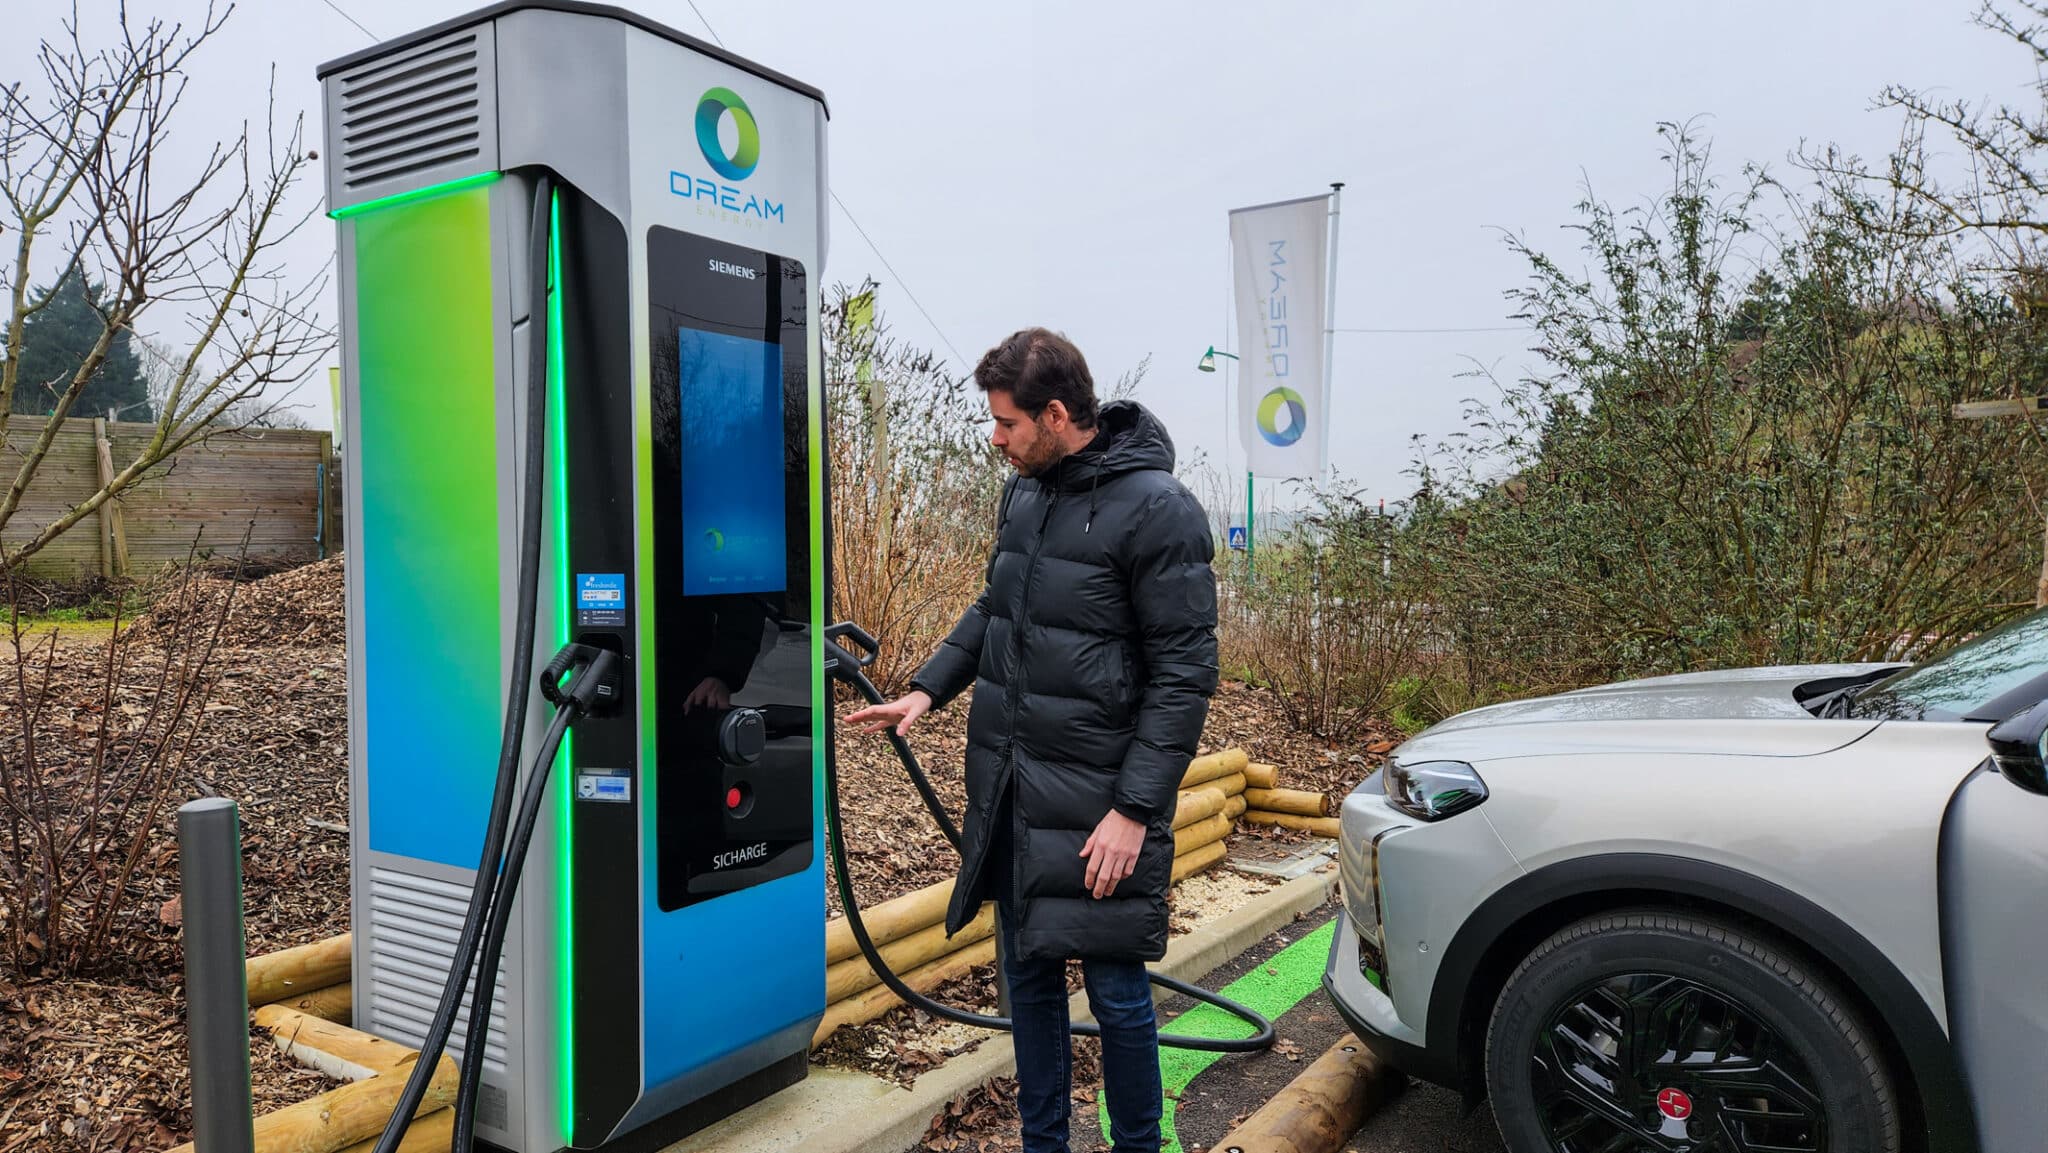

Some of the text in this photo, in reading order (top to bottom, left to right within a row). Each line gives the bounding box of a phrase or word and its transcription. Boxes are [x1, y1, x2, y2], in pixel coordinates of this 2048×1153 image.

[670, 170, 784, 224] DREAM
[709, 259, 755, 280] SIEMENS
[713, 842, 768, 870] SICHARGE
